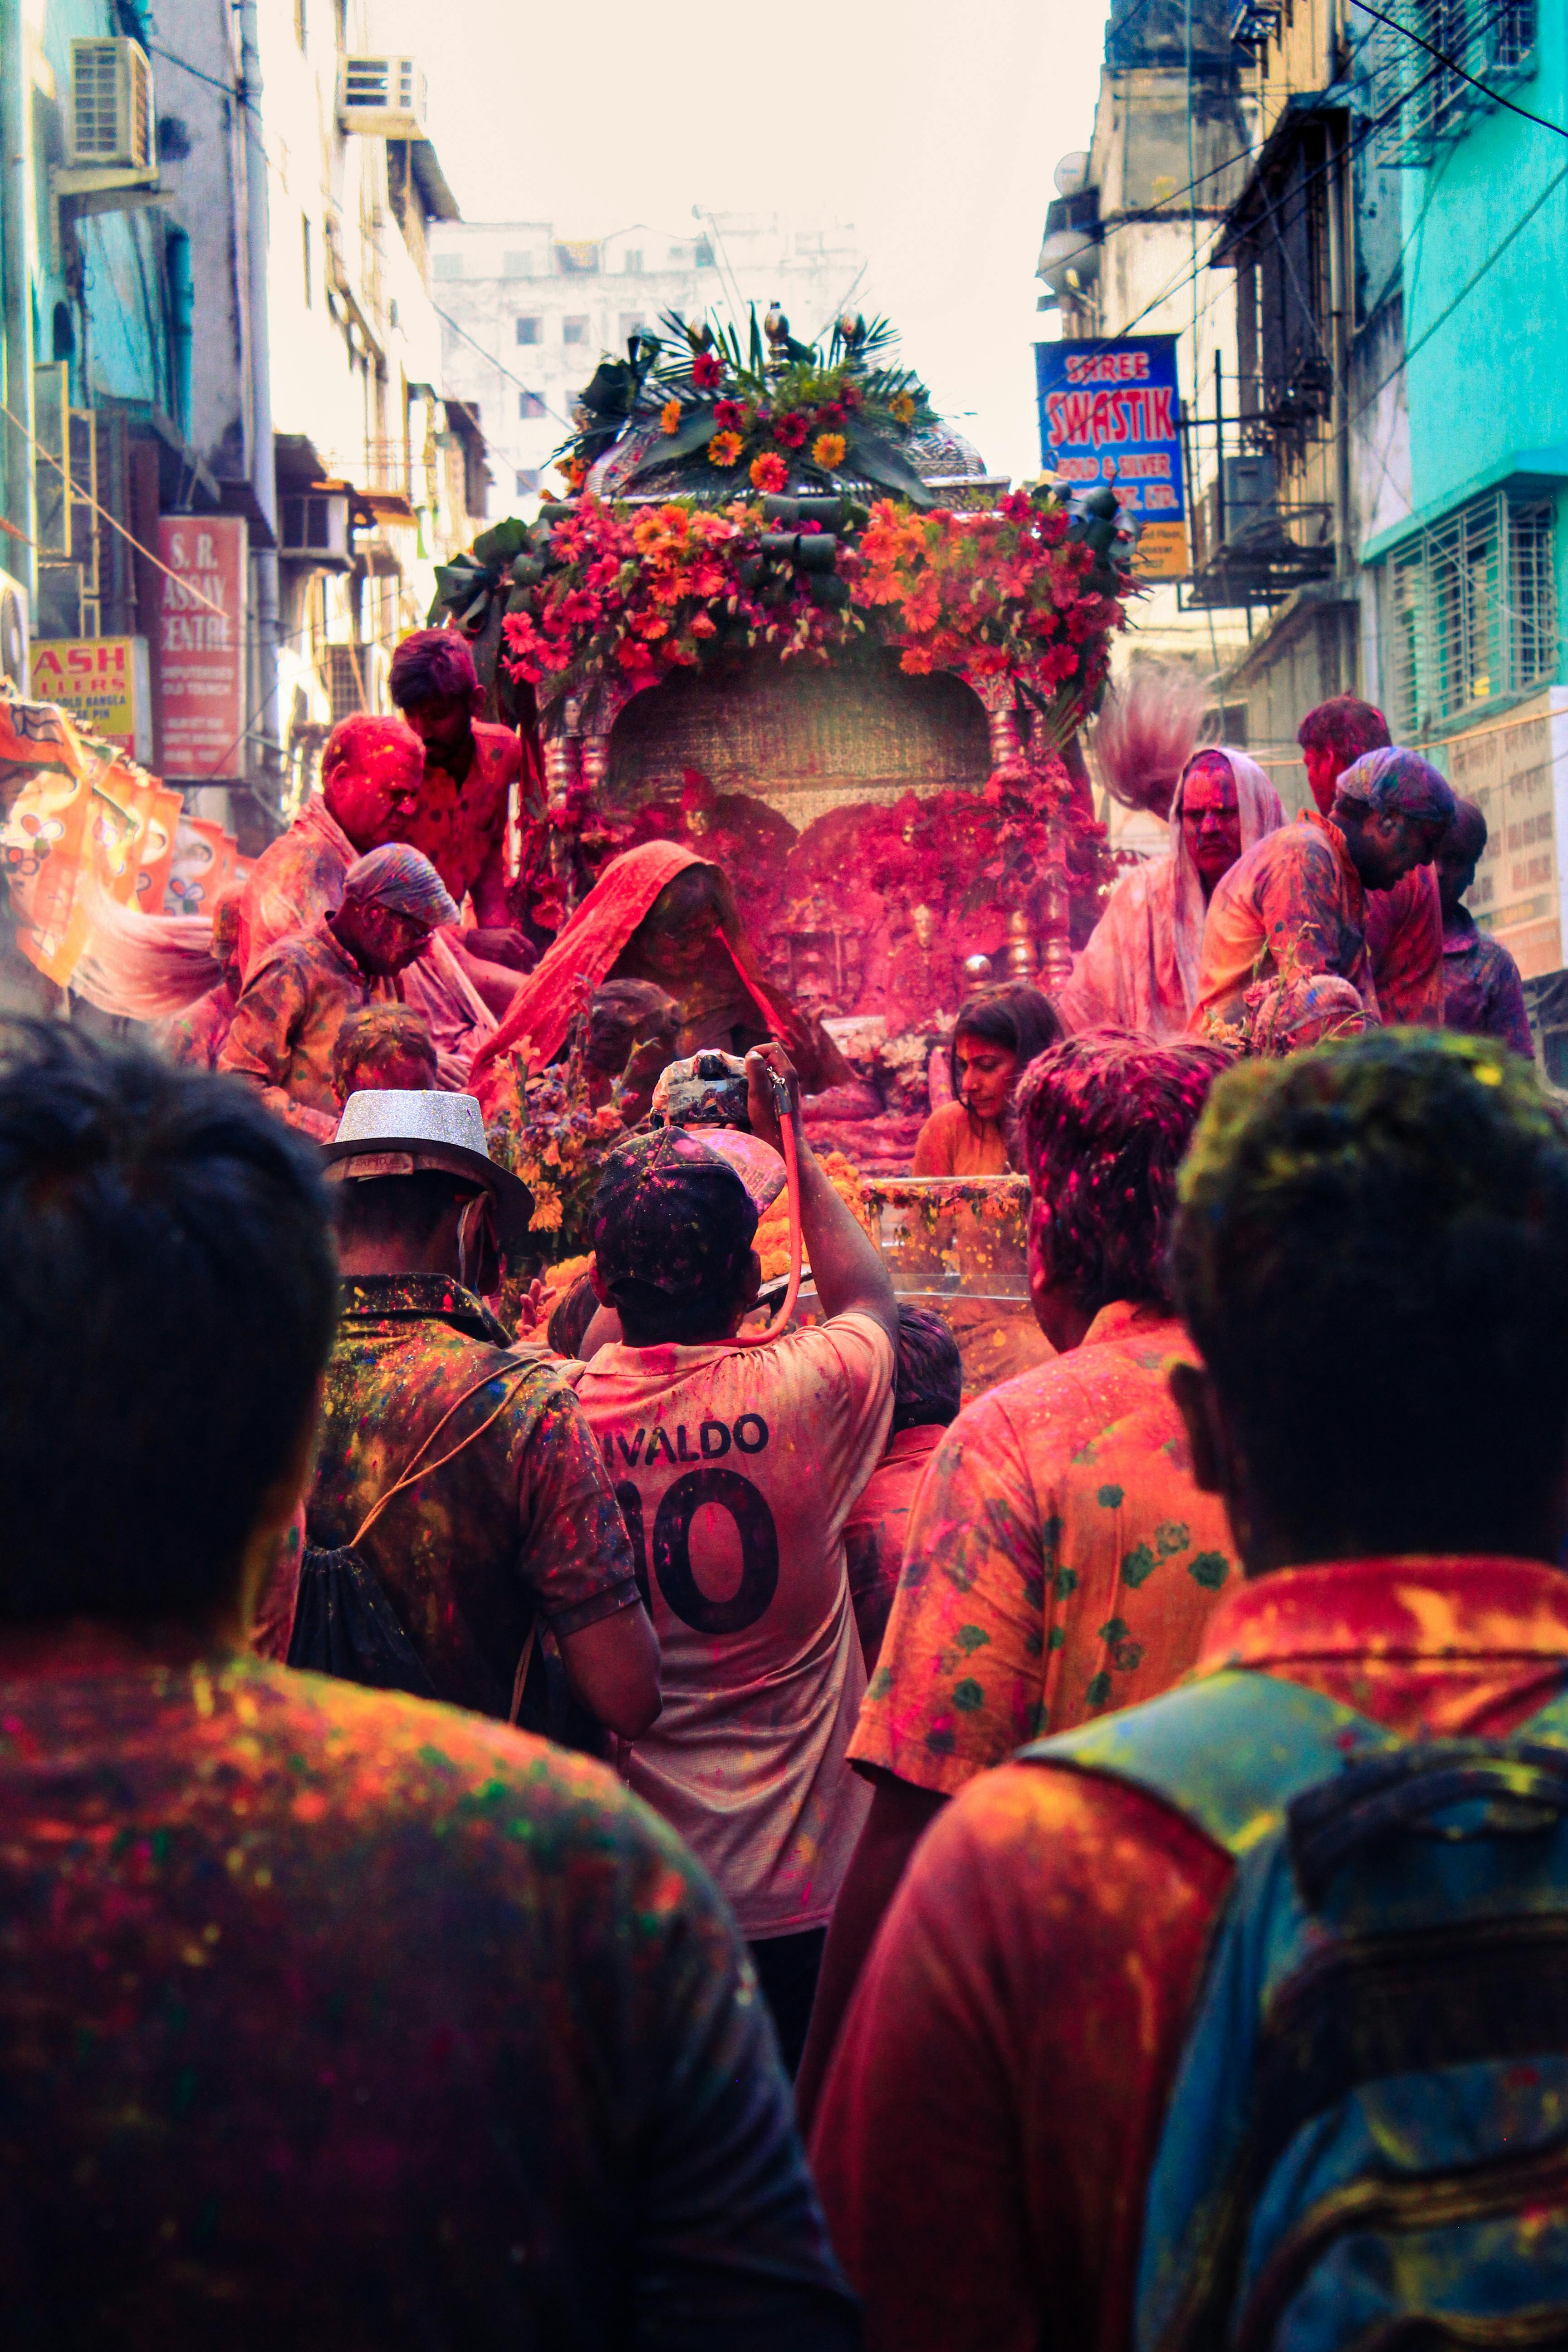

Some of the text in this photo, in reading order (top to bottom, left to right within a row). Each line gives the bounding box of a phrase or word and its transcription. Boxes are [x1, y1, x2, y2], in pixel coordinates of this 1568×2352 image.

[1064, 352, 1150, 385] SHREE
[1045, 387, 1176, 451] SWASTIK
[1102, 456, 1116, 480] &
[1118, 453, 1171, 479] SILVER
[1144, 484, 1179, 510] LTD.
[168, 533, 218, 569] S. R.
[163, 573, 227, 611] ASSAY
[32, 646, 124, 676] ASH
[595, 1413, 769, 1468] IVALDO
